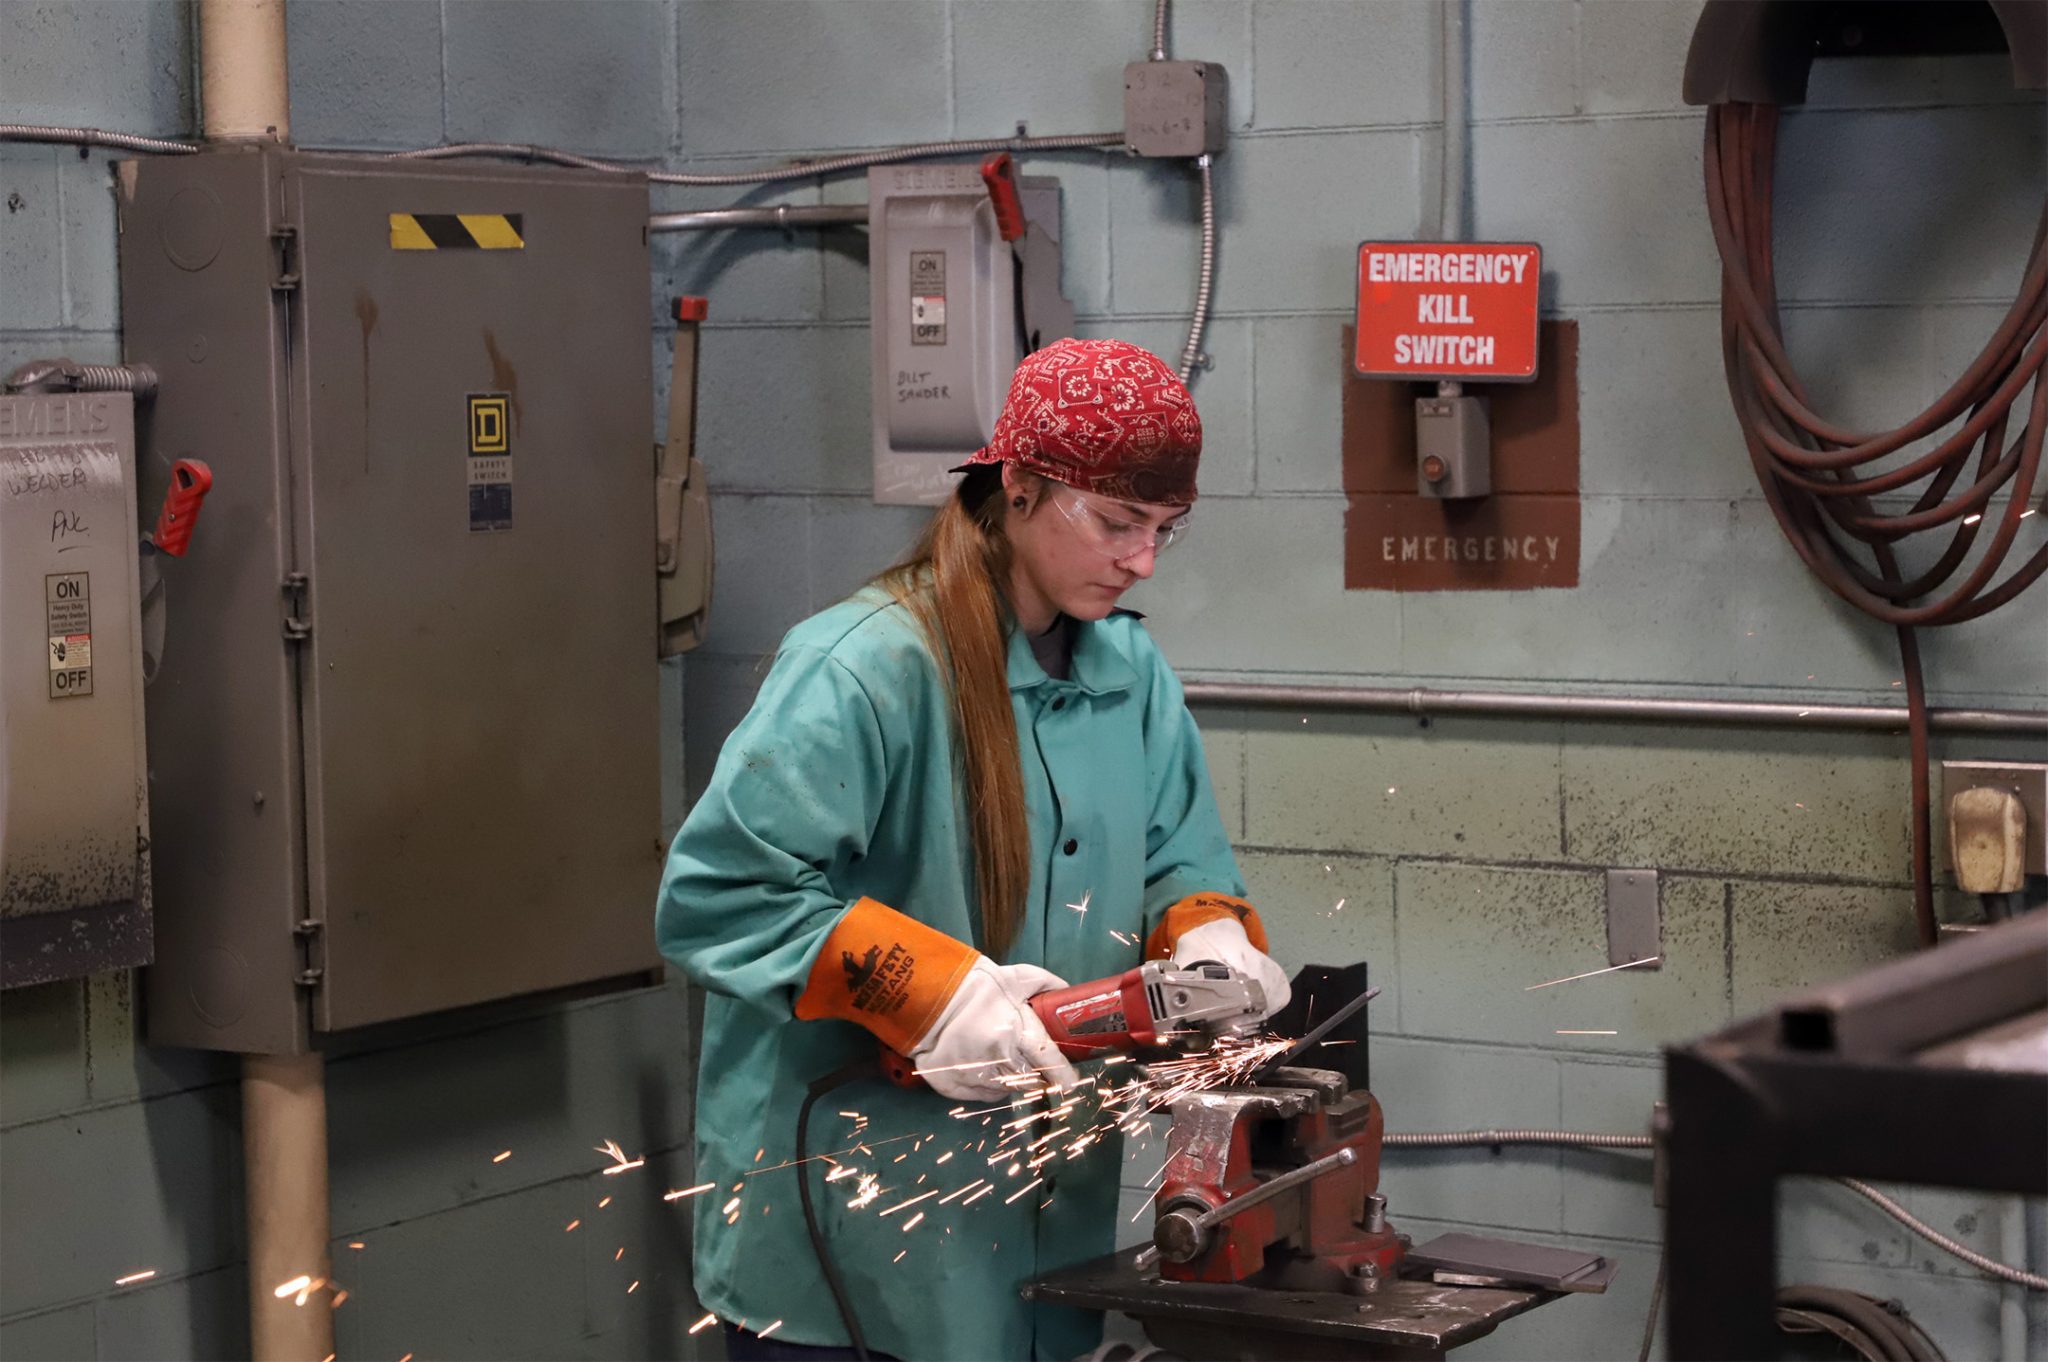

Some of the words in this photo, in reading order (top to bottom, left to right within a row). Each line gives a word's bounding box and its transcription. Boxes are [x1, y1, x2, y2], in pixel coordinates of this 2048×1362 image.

[918, 259, 937, 272] ON
[1369, 253, 1529, 284] EMERGENCY
[1418, 294, 1474, 324] KILL
[917, 324, 940, 337] OFF
[1394, 334, 1495, 365] SWITCH
[474, 460, 506, 469] SAFETY
[7, 466, 88, 496] WELDER
[474, 471, 507, 480] SWITCH
[1382, 536, 1560, 562] EMERGENCY
[56, 581, 80, 598] ON
[56, 670, 87, 689] OFF
